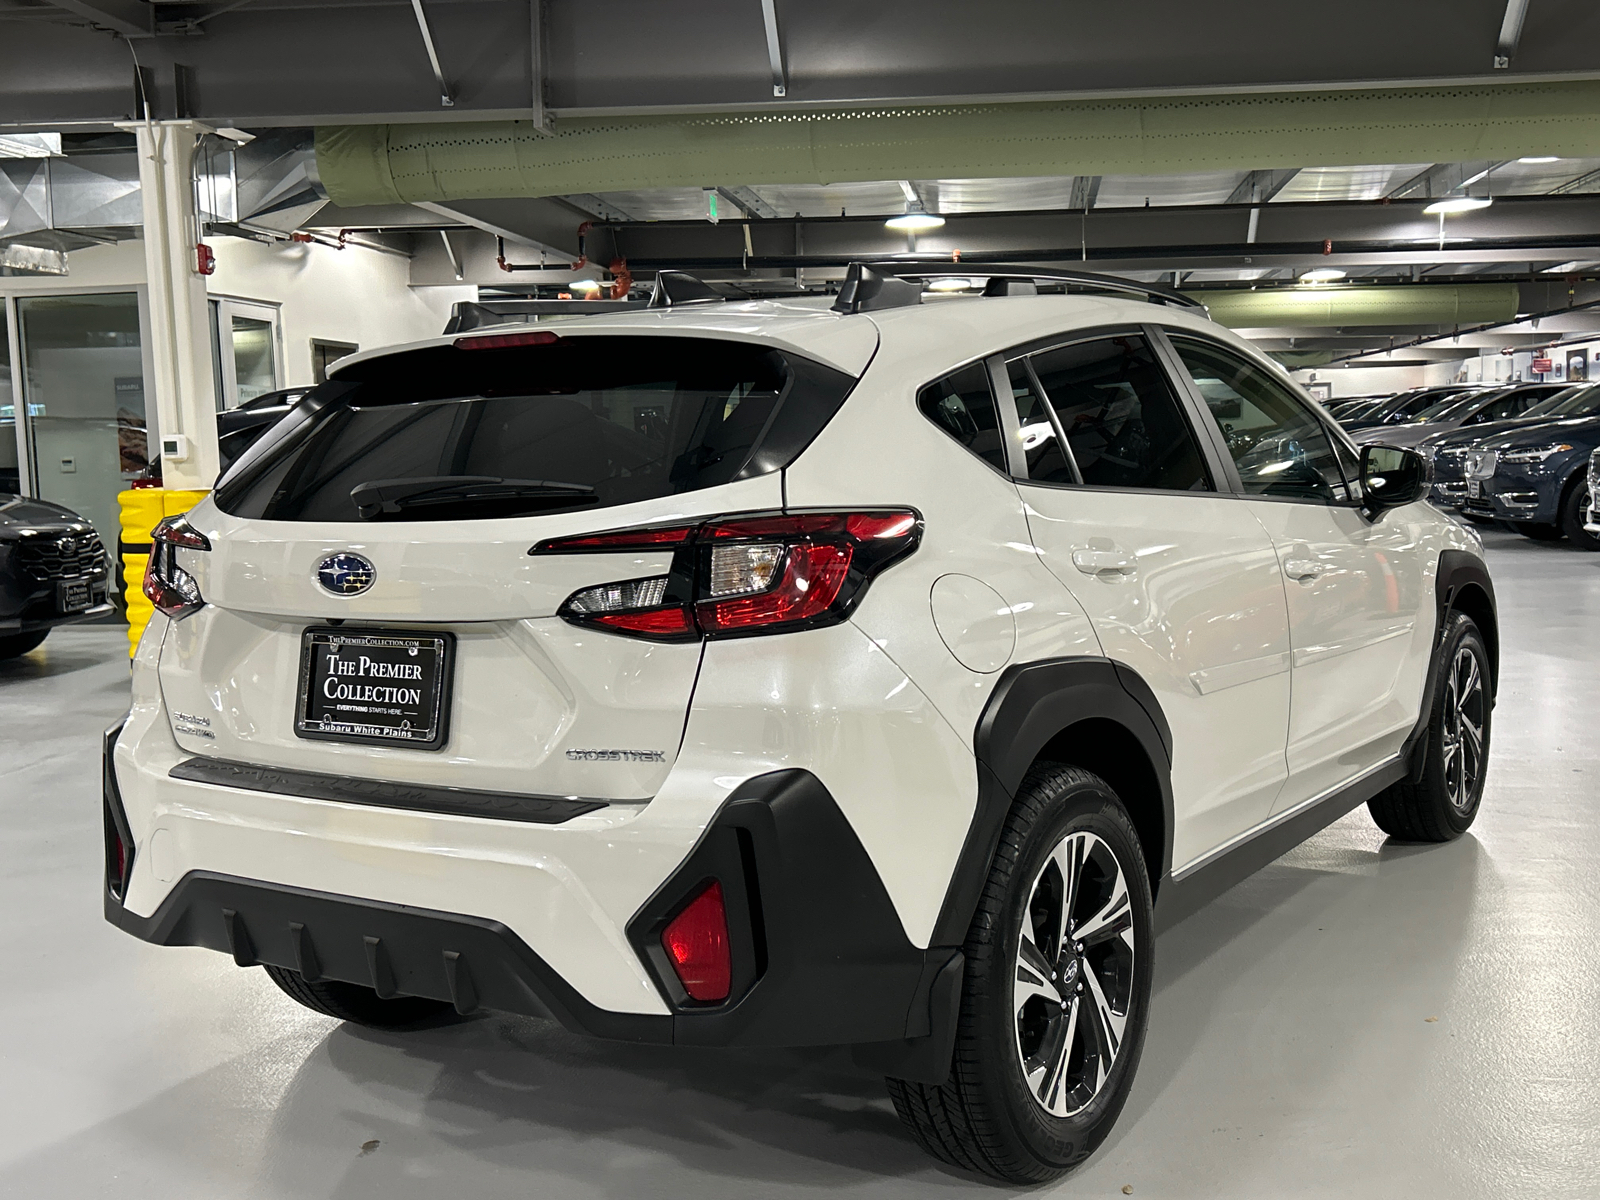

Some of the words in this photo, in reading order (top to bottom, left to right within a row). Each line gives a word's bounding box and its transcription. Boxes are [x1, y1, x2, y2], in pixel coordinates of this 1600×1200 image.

[326, 654, 356, 676] THE
[357, 656, 423, 680] PREMIER
[323, 677, 421, 705] COLLECTION
[336, 704, 368, 713] EVERYTHING
[369, 707, 387, 715] STARTS
[319, 722, 351, 733] Subaru
[353, 725, 380, 735] White
[383, 728, 413, 738] Plains
[565, 748, 666, 763] CROSSTREK
